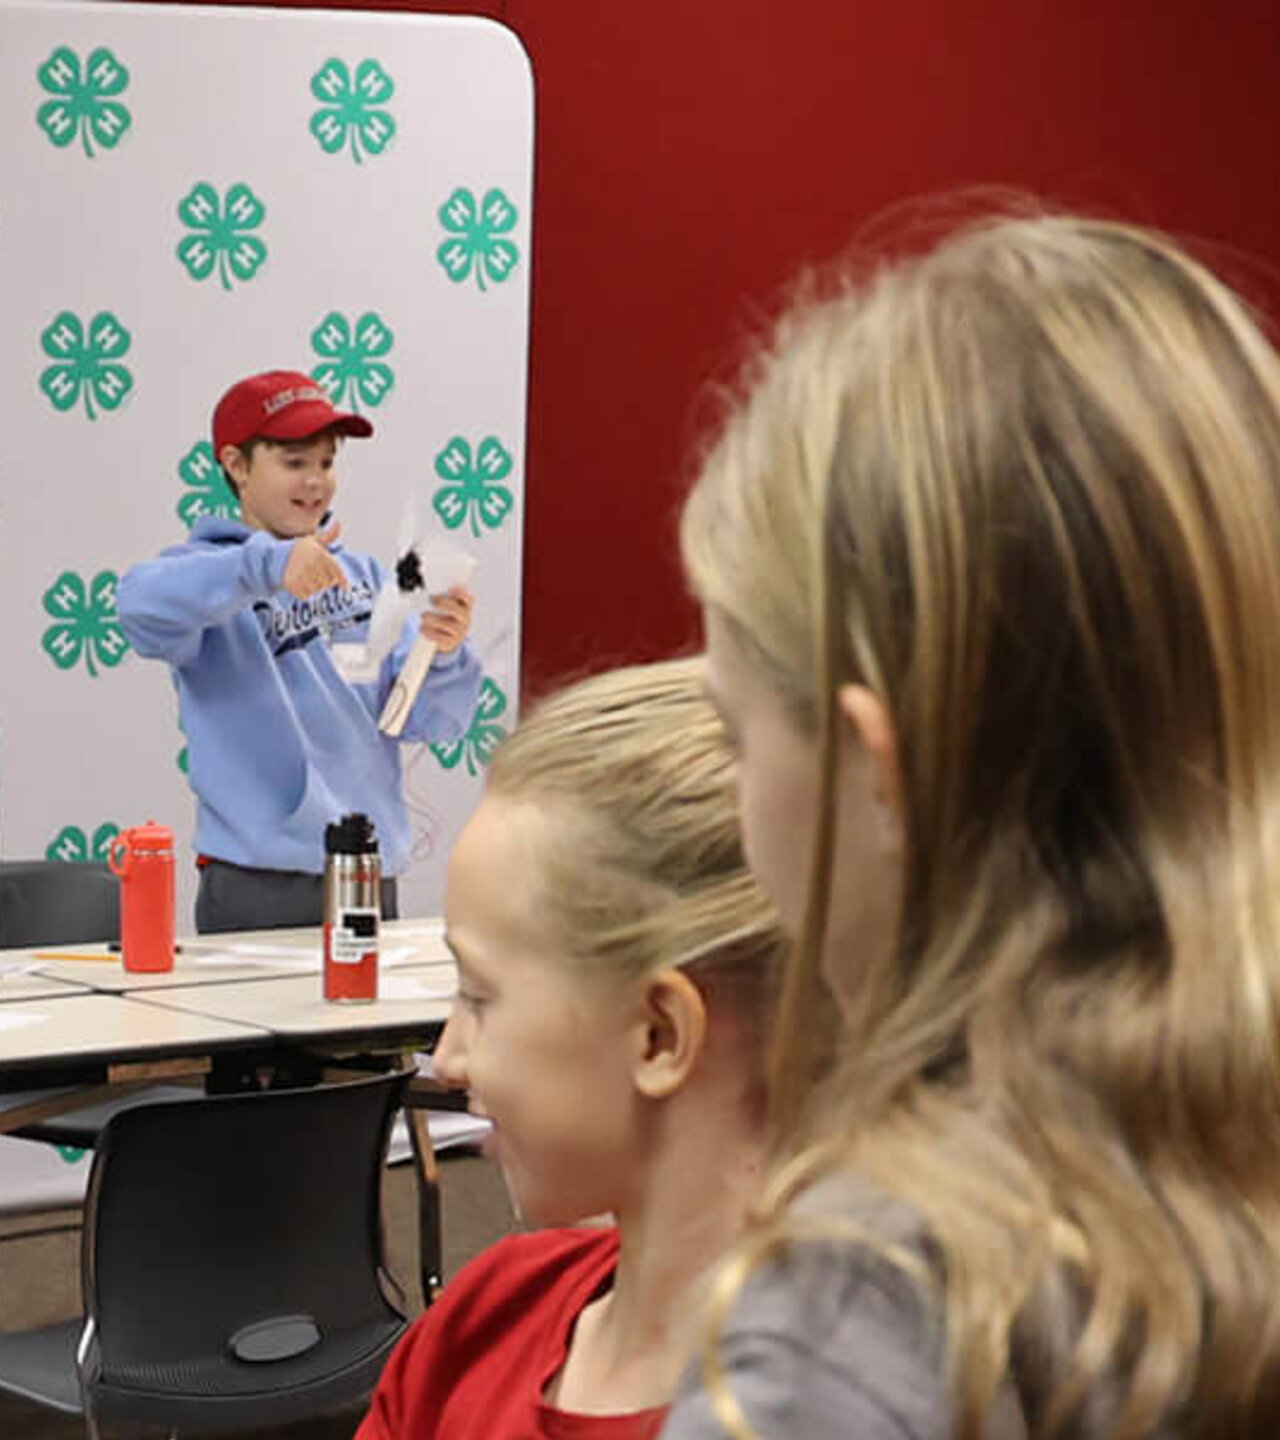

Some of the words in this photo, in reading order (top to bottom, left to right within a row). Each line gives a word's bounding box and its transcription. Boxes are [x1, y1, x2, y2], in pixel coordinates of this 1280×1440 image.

[49, 60, 73, 87] H
[93, 63, 118, 88] H
[322, 71, 342, 97] H
[363, 71, 384, 97] H
[46, 108, 71, 134] H
[98, 111, 122, 135] H
[318, 117, 341, 141] H
[366, 118, 387, 142] H
[188, 197, 213, 221] H
[232, 196, 254, 221] H
[449, 202, 471, 225] H
[487, 202, 508, 223] H
[236, 244, 257, 269] H
[446, 246, 467, 270] H
[492, 246, 510, 271] H
[52, 325, 77, 350] H
[97, 327, 121, 350] H
[323, 325, 343, 350] H
[363, 325, 383, 350] H
[51, 373, 73, 398] H
[100, 373, 123, 398] H
[365, 371, 385, 395] H
[190, 453, 212, 479] H
[444, 451, 466, 471] H
[482, 450, 502, 472] H
[443, 493, 463, 517] H
[485, 495, 506, 516] H
[53, 586, 78, 610] H
[54, 630, 75, 657] H
[101, 629, 124, 654] H
